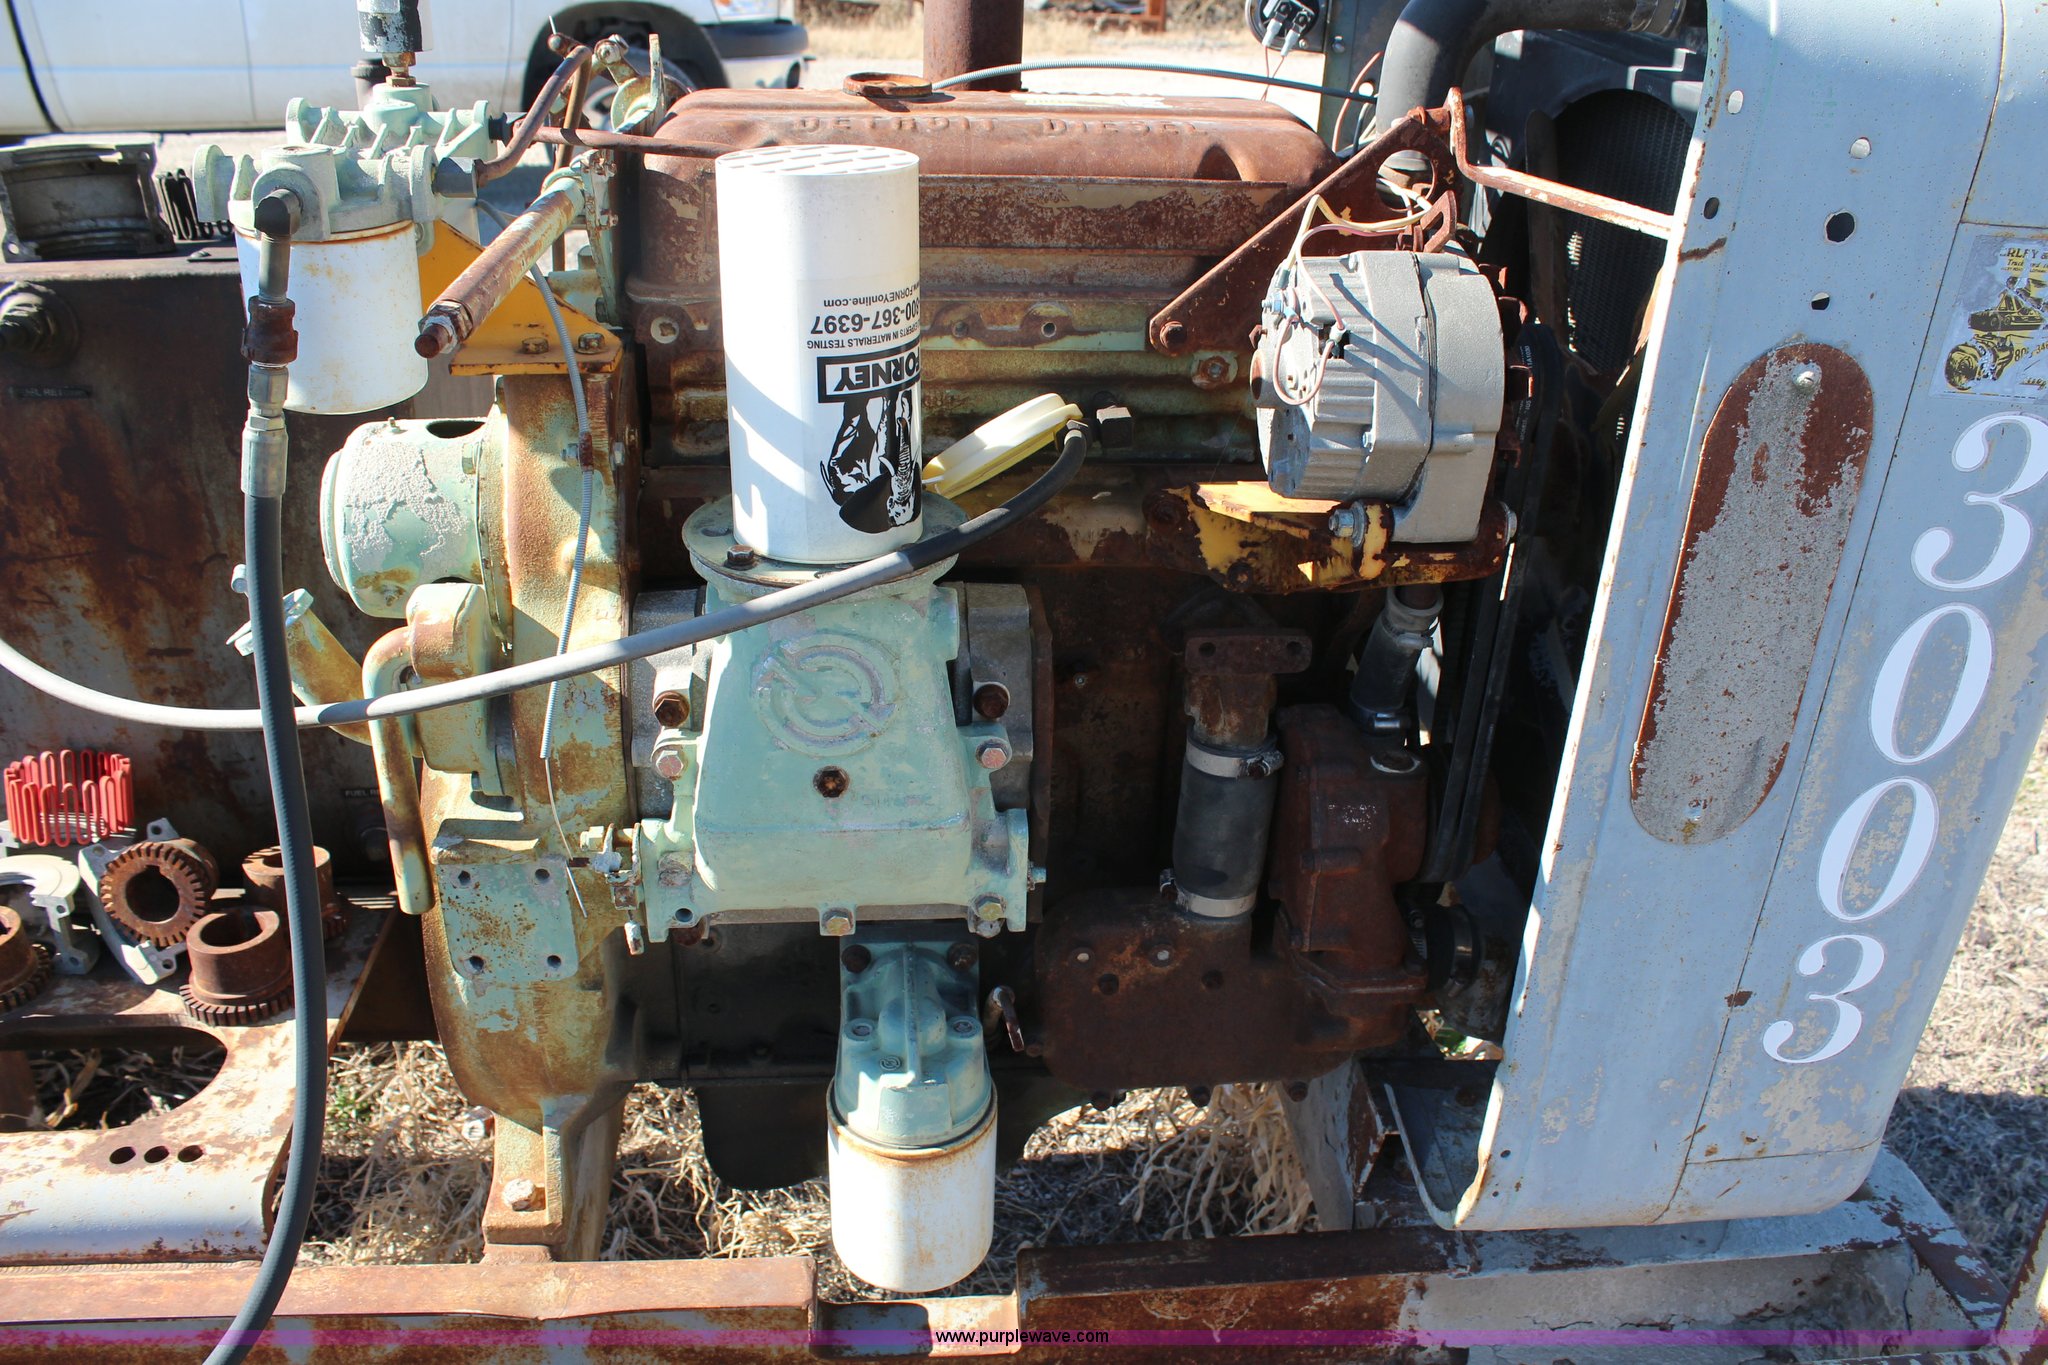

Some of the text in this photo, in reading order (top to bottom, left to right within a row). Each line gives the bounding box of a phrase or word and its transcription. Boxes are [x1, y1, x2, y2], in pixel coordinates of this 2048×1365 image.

[795, 115, 1209, 137] DETROIT DIESEL
[807, 339, 846, 349] TESTING
[847, 331, 891, 348] MATERIALS
[833, 346, 920, 392] FORNEY
[1760, 411, 2048, 1065] 3003
